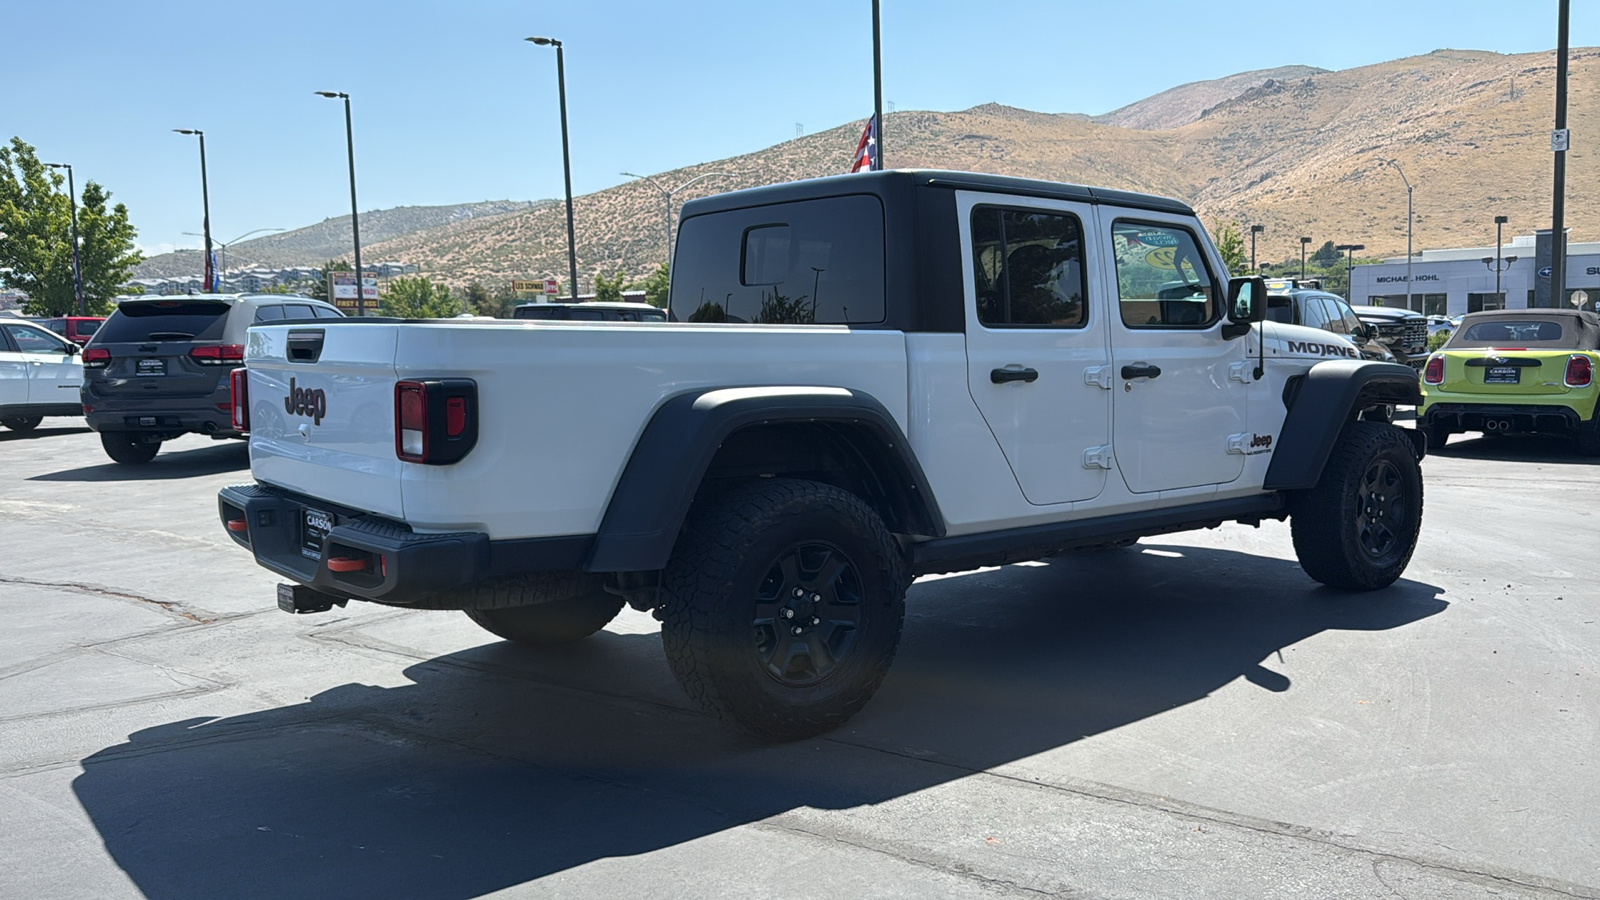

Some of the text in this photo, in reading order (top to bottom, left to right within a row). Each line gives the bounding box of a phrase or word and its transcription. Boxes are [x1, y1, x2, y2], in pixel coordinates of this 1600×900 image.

[1415, 274, 1440, 282] HOHL
[336, 300, 355, 308] FAST
[1287, 340, 1358, 359] MOJAVE
[284, 376, 327, 427] Jeep
[1250, 433, 1272, 448] Jeep
[306, 515, 332, 533] CARSON
